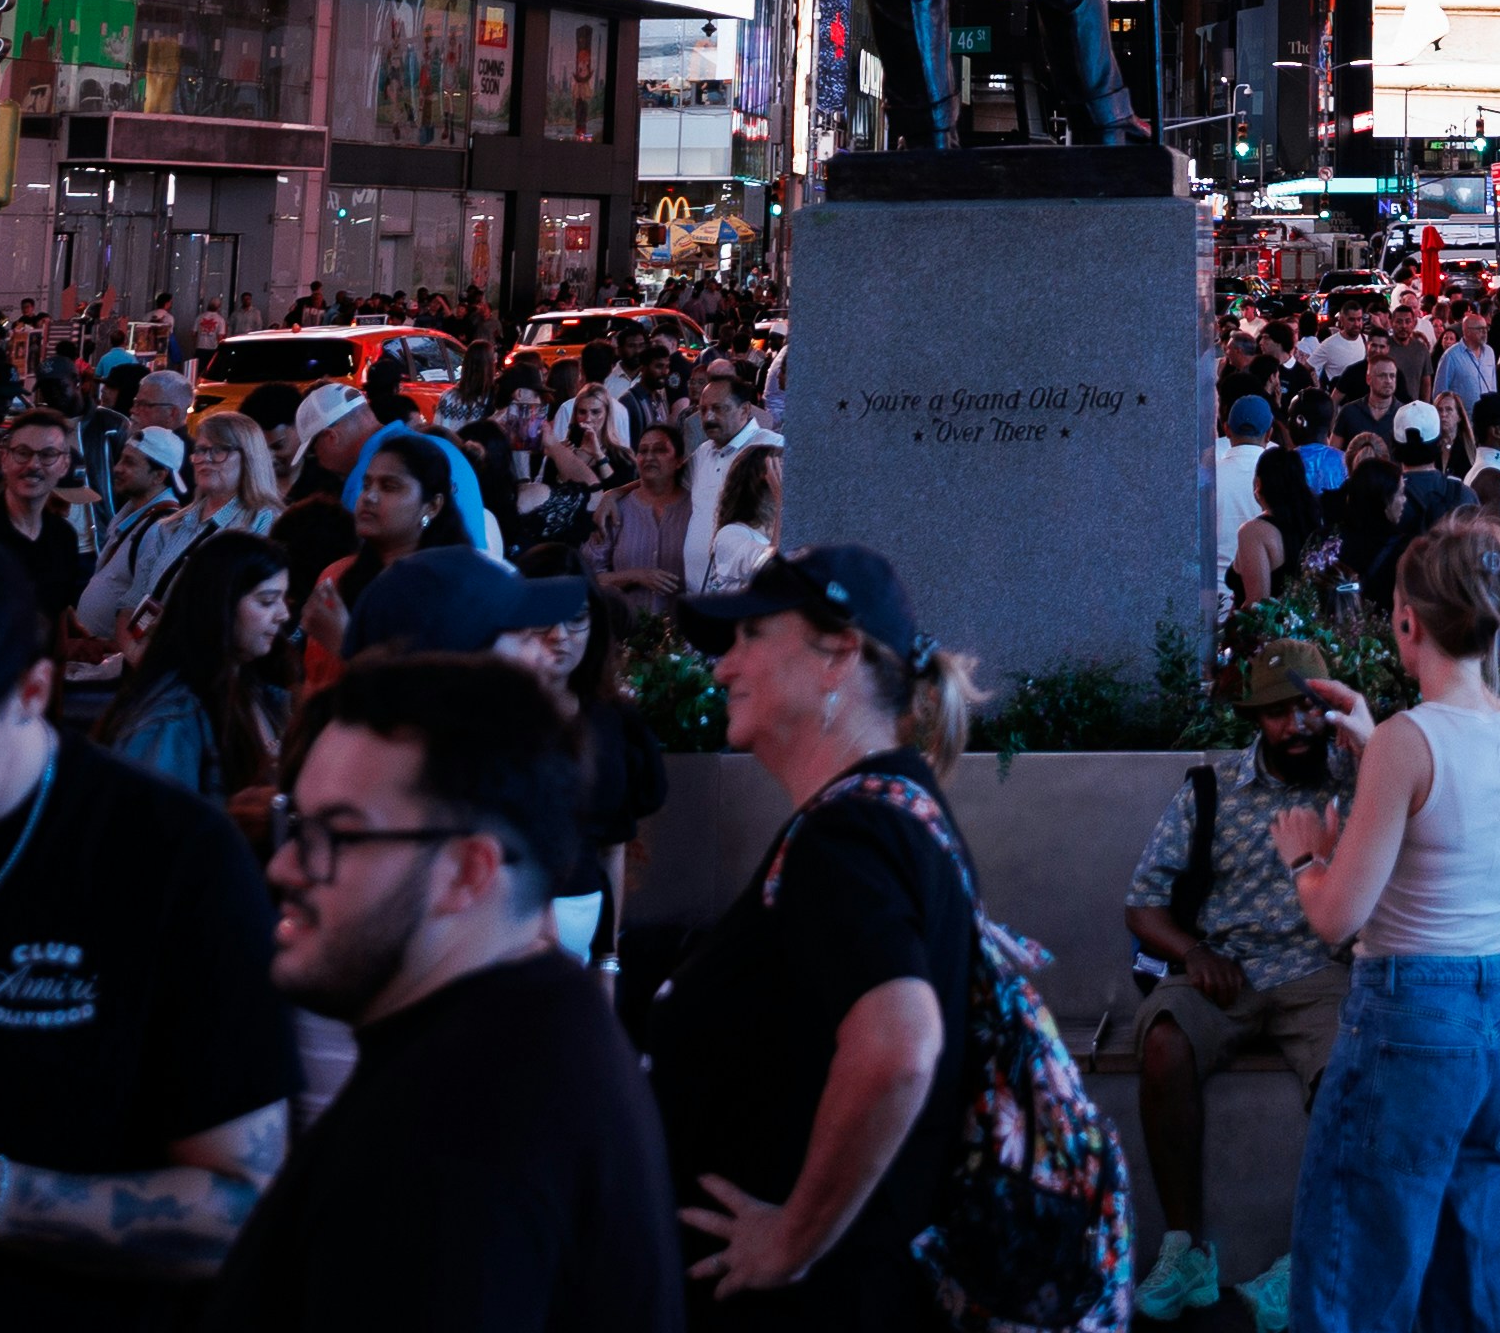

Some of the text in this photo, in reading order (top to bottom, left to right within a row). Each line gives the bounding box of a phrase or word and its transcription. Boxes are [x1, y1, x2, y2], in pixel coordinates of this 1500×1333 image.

[858, 383, 1124, 419] You're a Grand Old Flag
[931, 417, 1047, 443] Over There
[9, 940, 85, 968] CLUB
